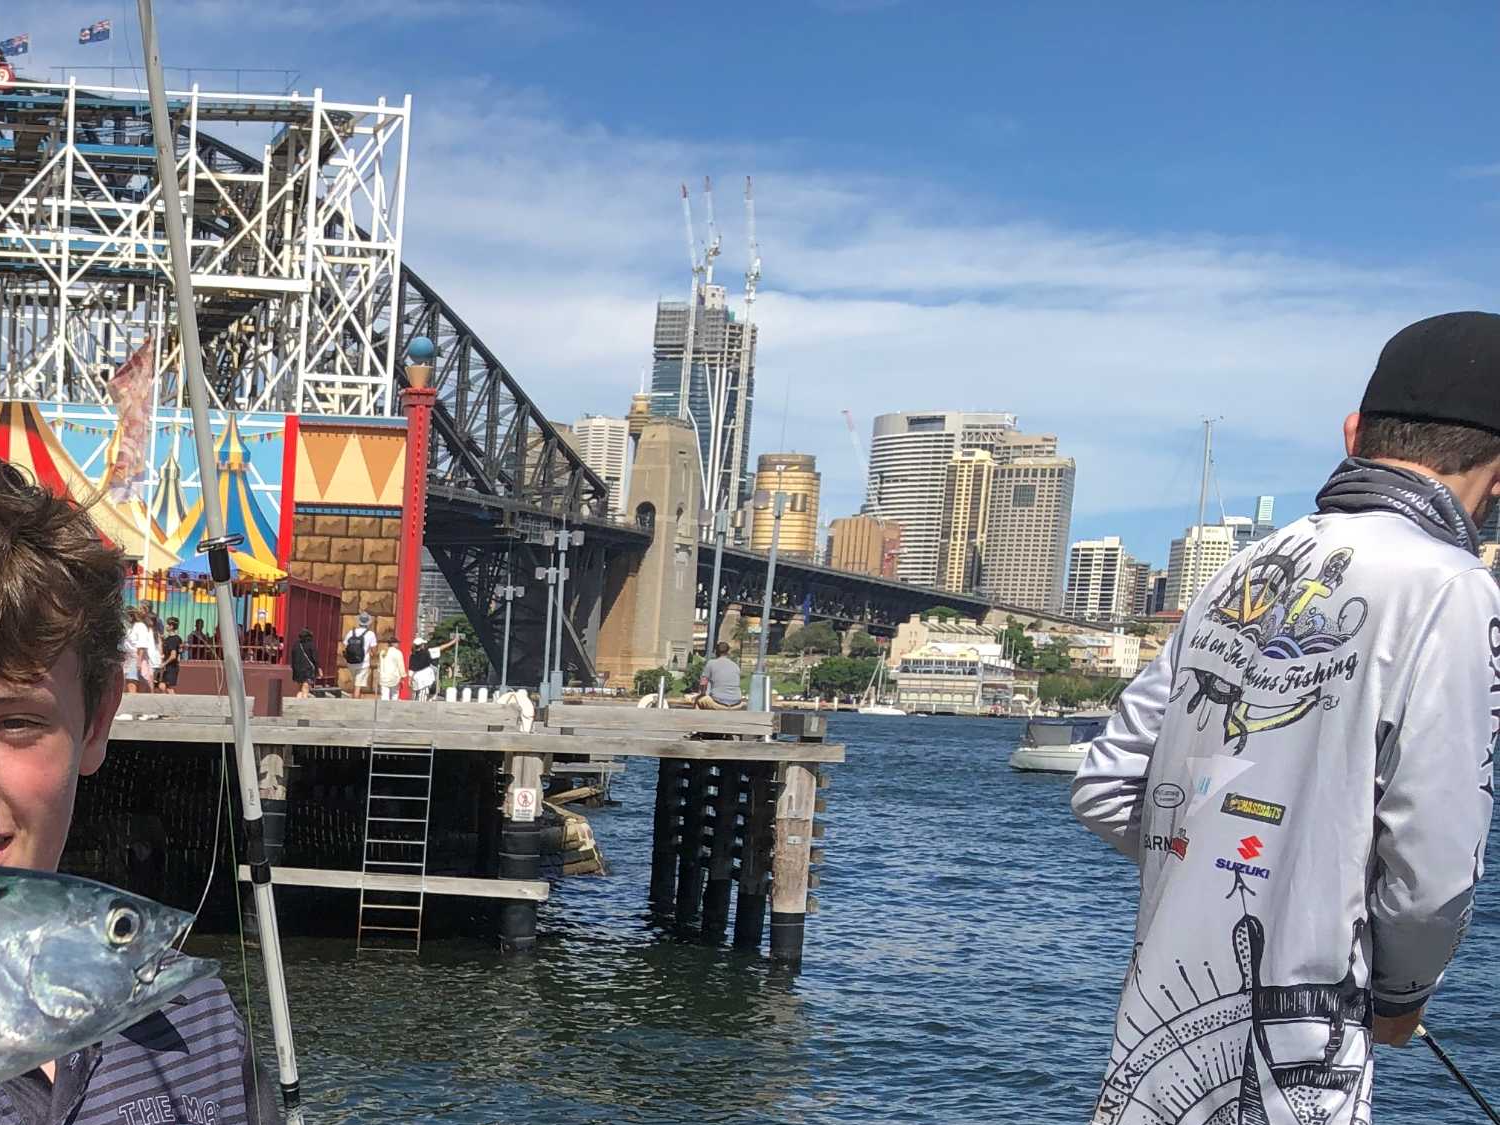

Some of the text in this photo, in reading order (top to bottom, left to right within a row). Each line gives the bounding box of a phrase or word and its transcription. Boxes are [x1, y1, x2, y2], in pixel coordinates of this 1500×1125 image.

[1209, 637, 1228, 656] on
[1223, 637, 1248, 669] The
[1279, 651, 1360, 695] Fishing
[1214, 858, 1271, 880] SUZUKI
